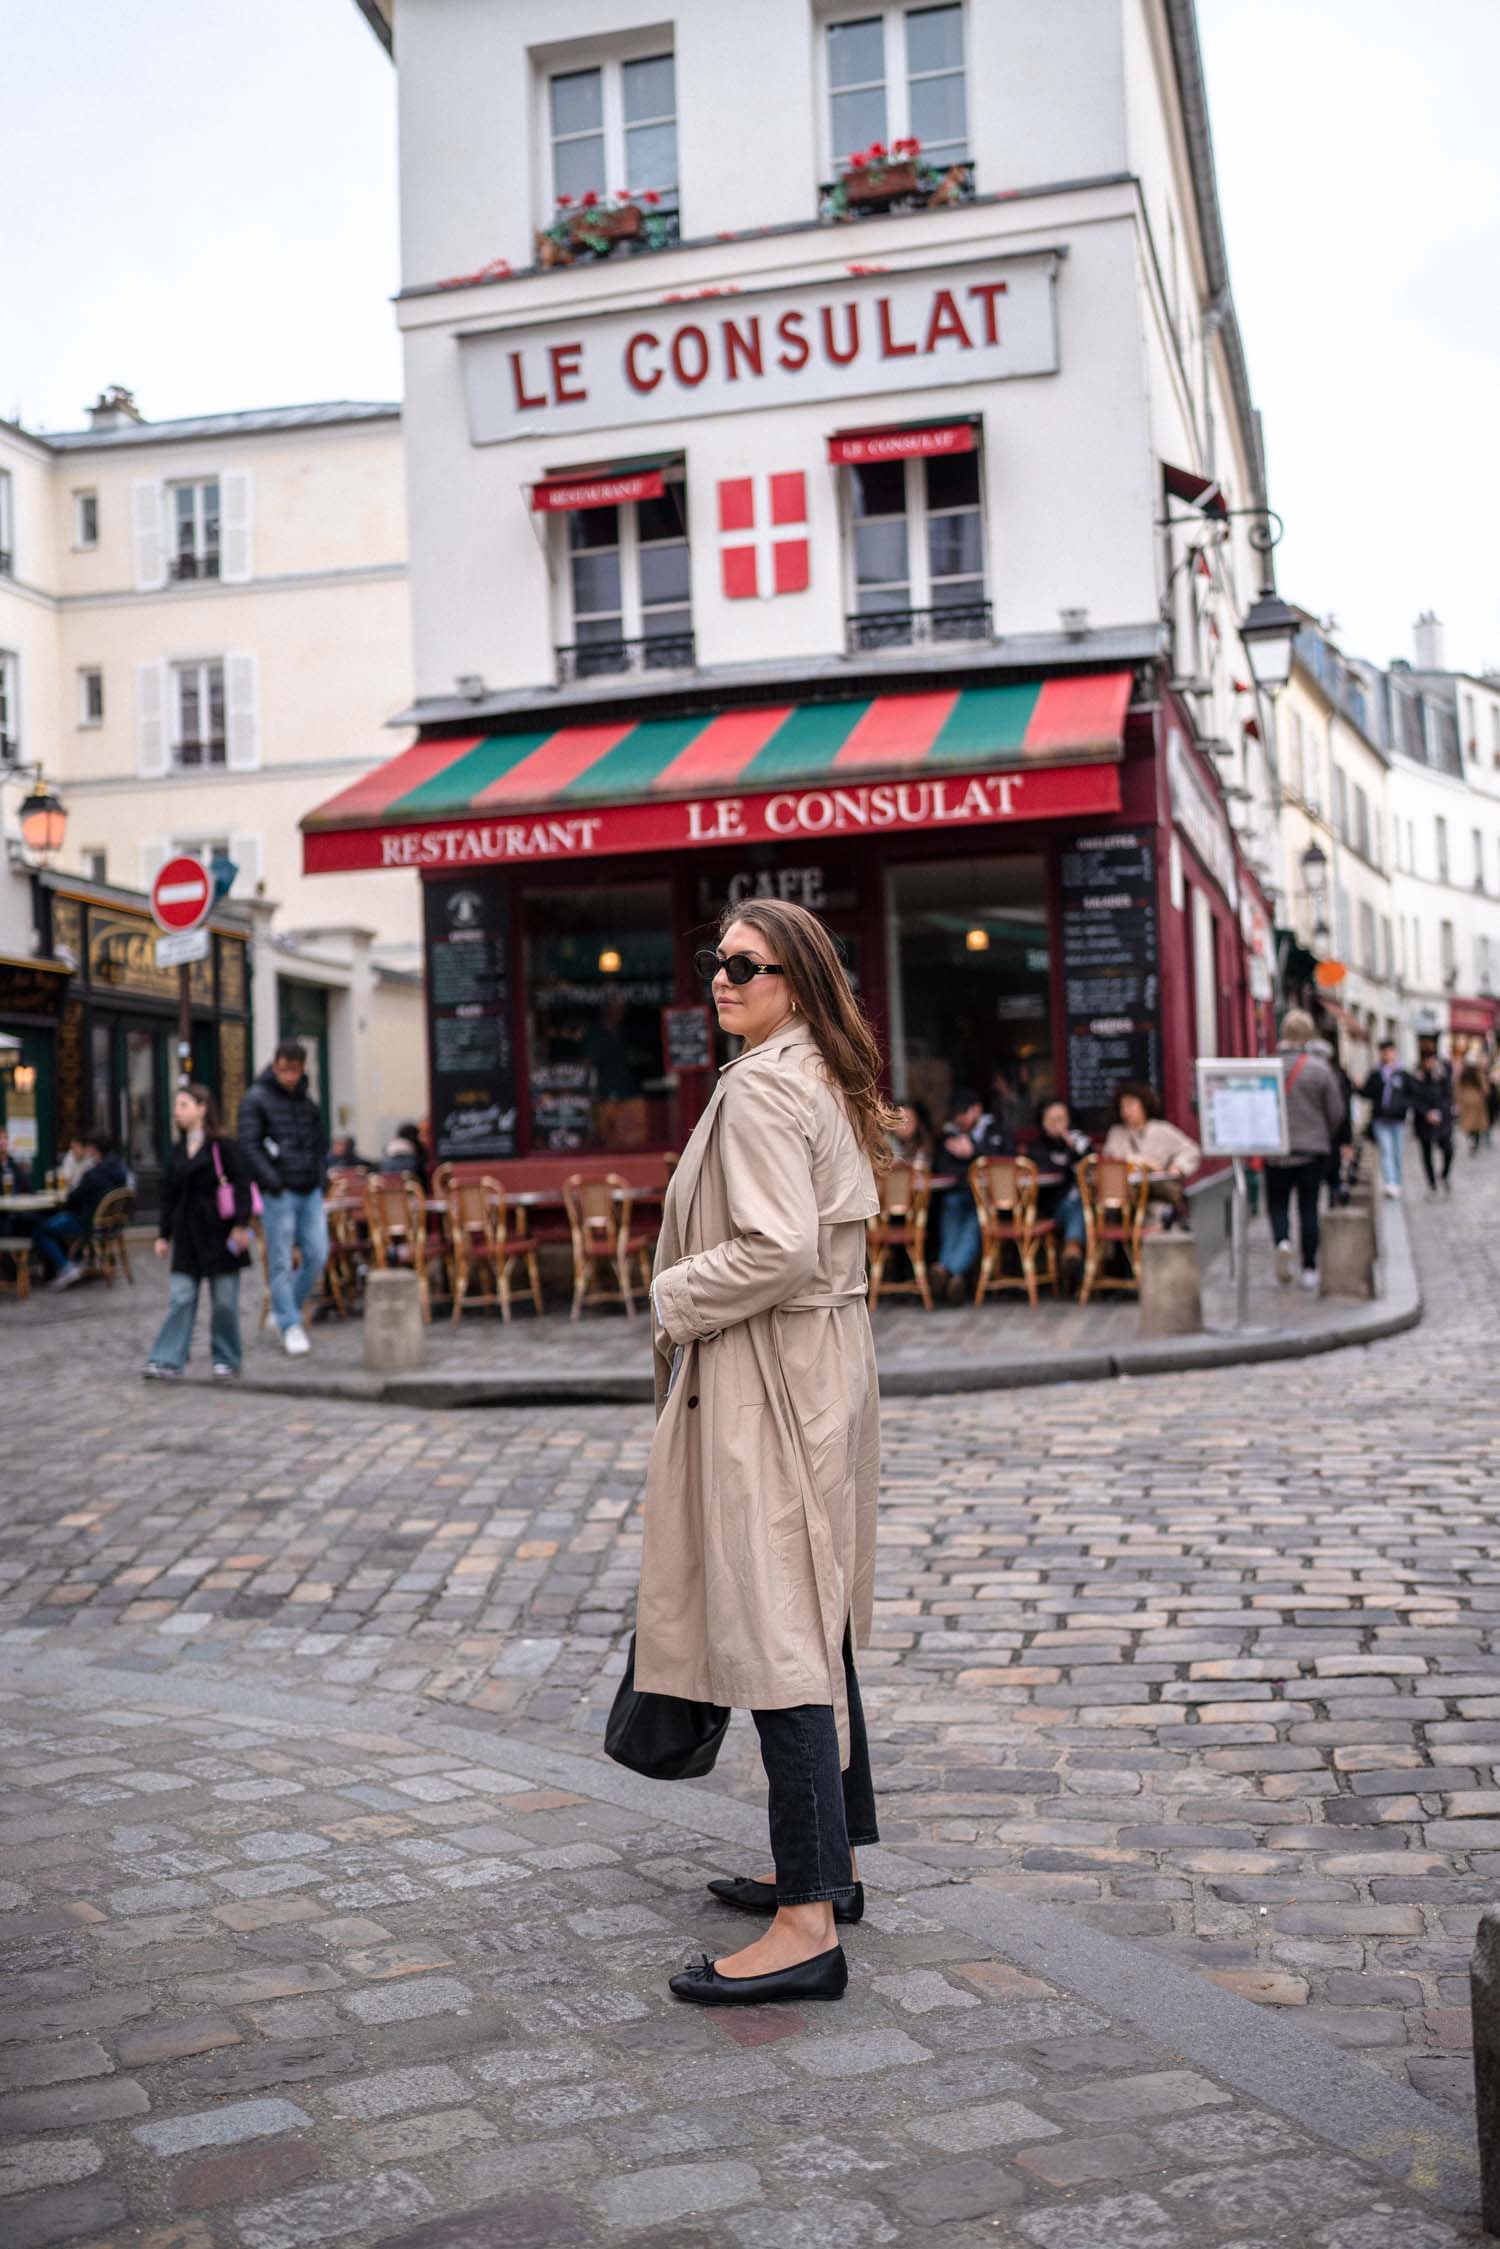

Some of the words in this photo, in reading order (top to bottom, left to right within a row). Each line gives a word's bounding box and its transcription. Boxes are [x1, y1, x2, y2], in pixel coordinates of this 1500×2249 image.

[509, 340, 588, 411] LE
[624, 280, 1008, 394] CONSULAT
[687, 799, 746, 840] LE
[764, 774, 1023, 834] CONSULAT
[380, 818, 602, 865] RESTAURANT
